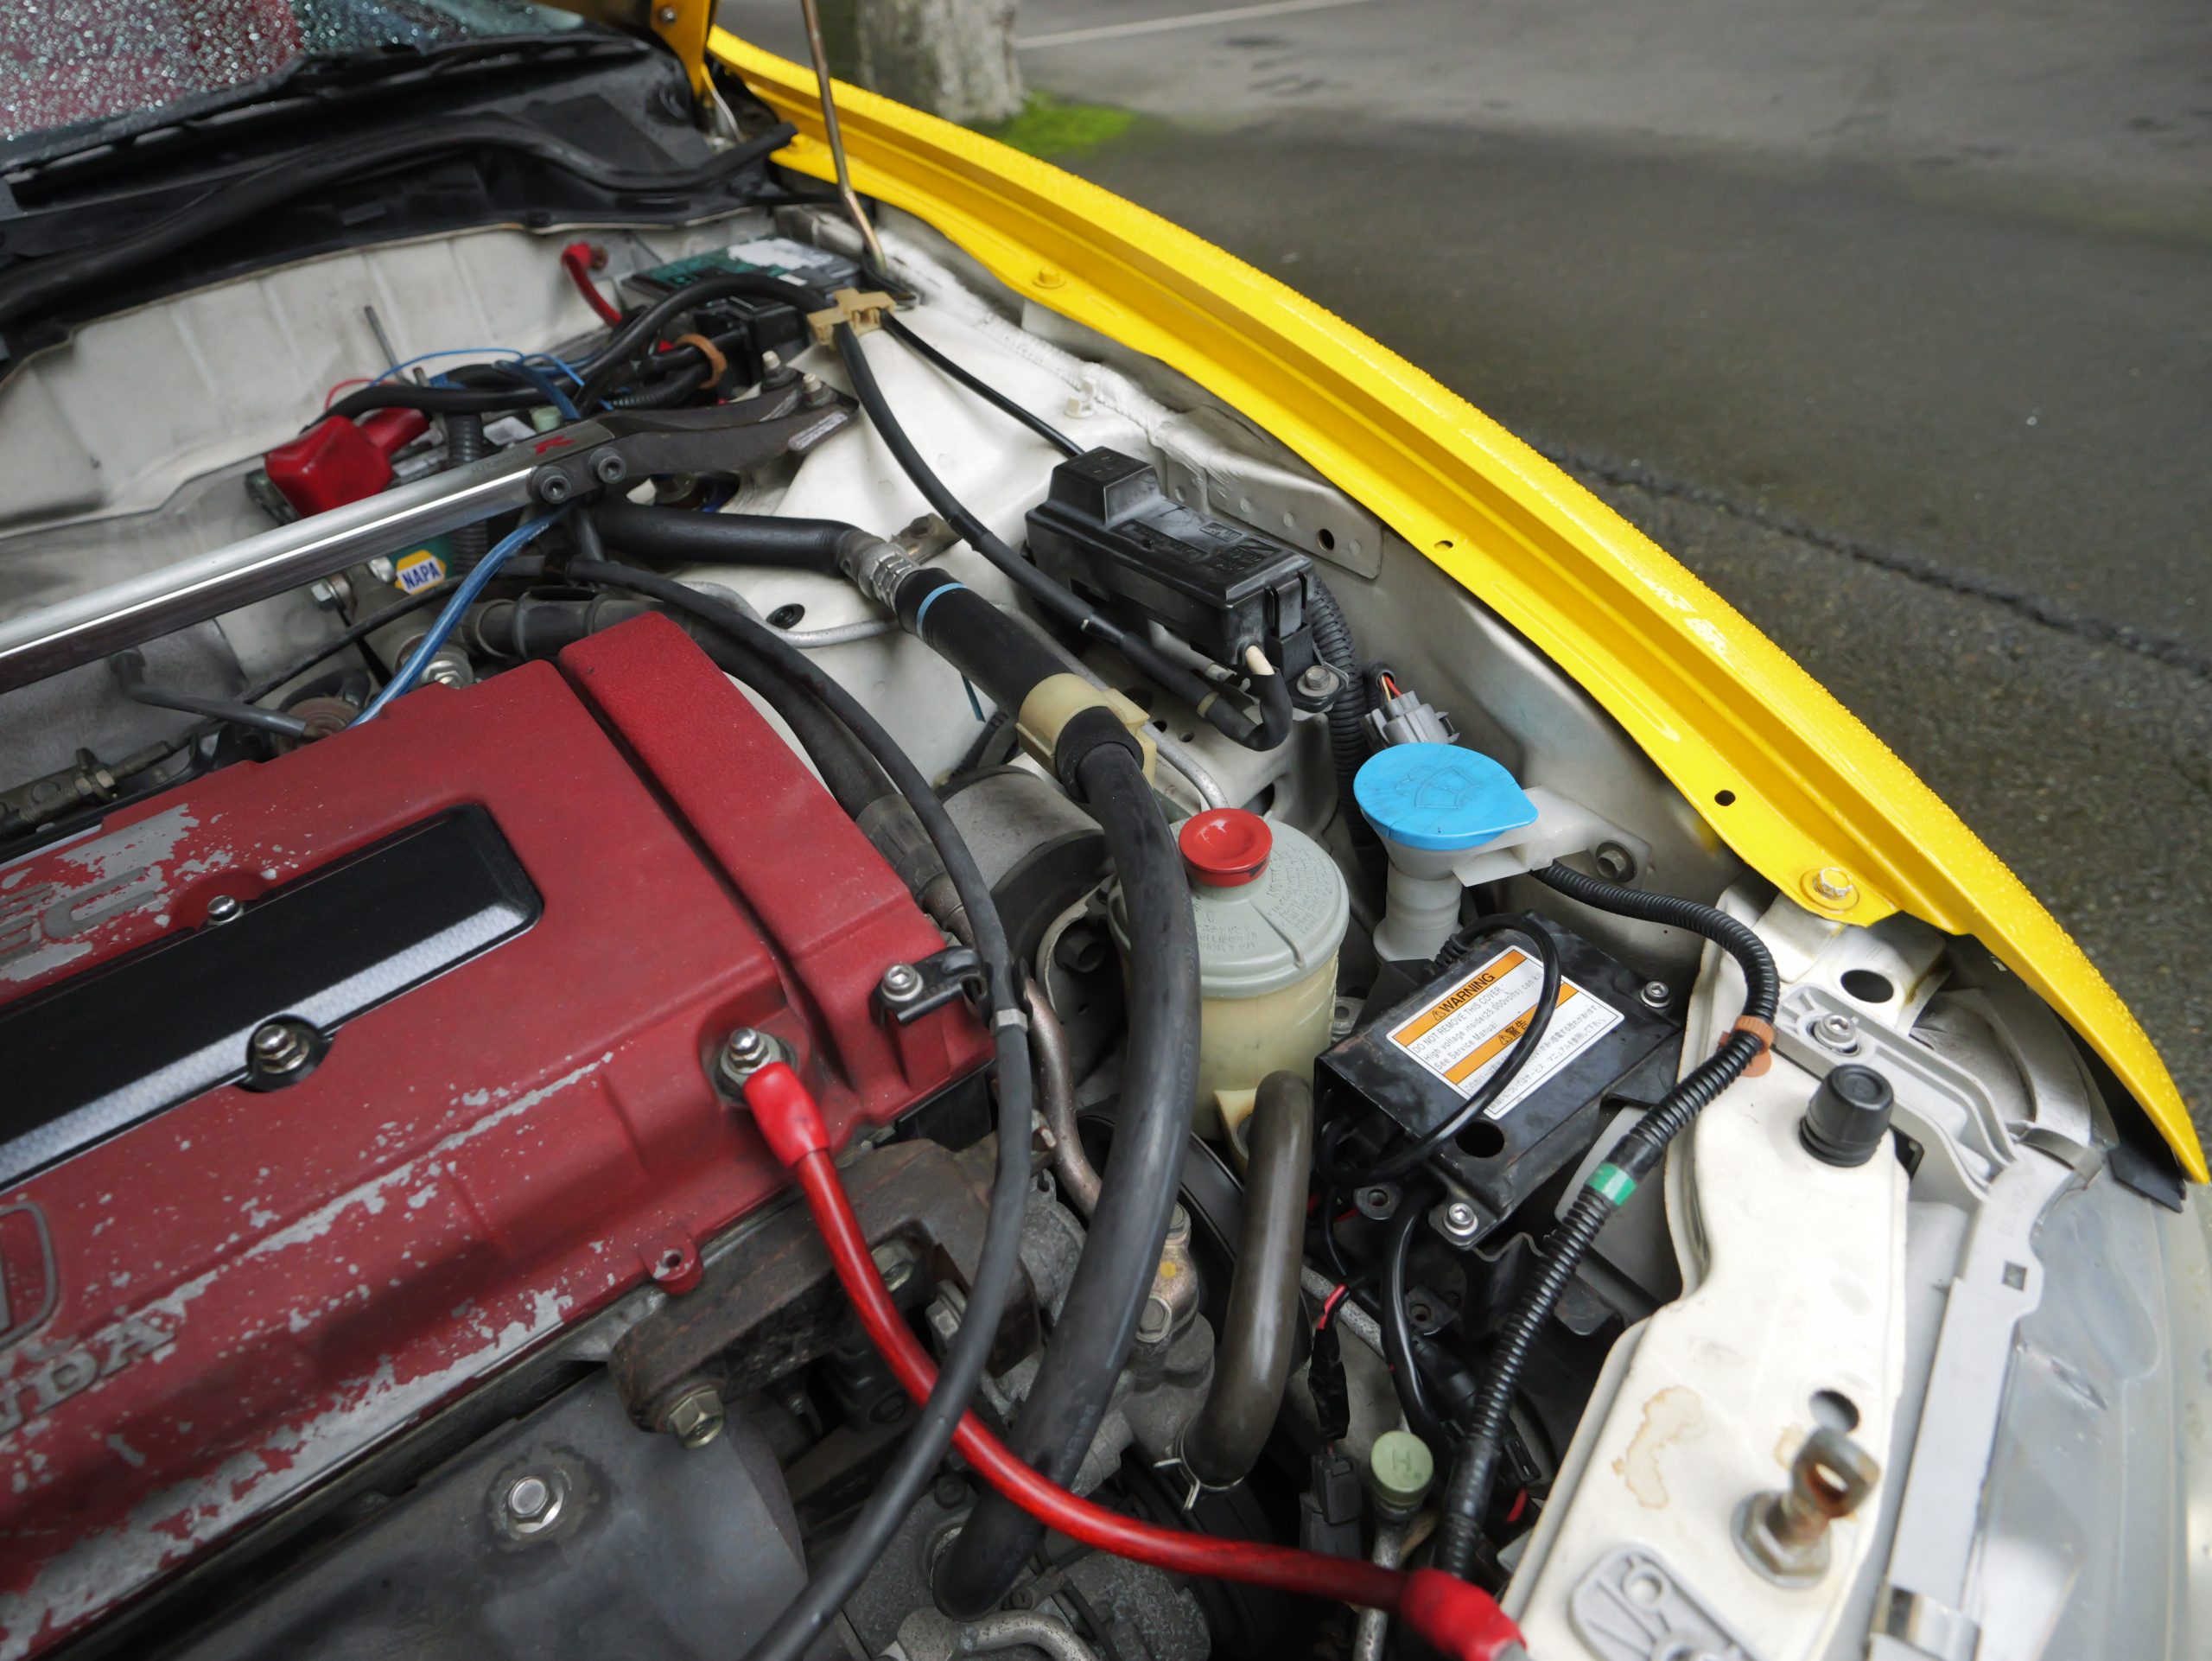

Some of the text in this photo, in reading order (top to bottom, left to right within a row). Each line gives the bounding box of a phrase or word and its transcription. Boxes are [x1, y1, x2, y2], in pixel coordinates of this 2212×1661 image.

[402, 562, 441, 589] NAPA
[1438, 971, 1496, 1013] WARNING
[1411, 1042, 1426, 1053] DO
[1421, 1032, 1440, 1045] NOT
[1436, 1012, 1467, 1035] REMOVE
[1463, 1002, 1482, 1015] THIS
[1422, 1047, 1443, 1063] High
[1438, 1029, 1467, 1051] voltage
[1519, 979, 1535, 990] can
[1504, 1018, 1529, 1038] 警告
[1433, 1056, 1451, 1070] See
[1446, 1038, 1475, 1060] Service
